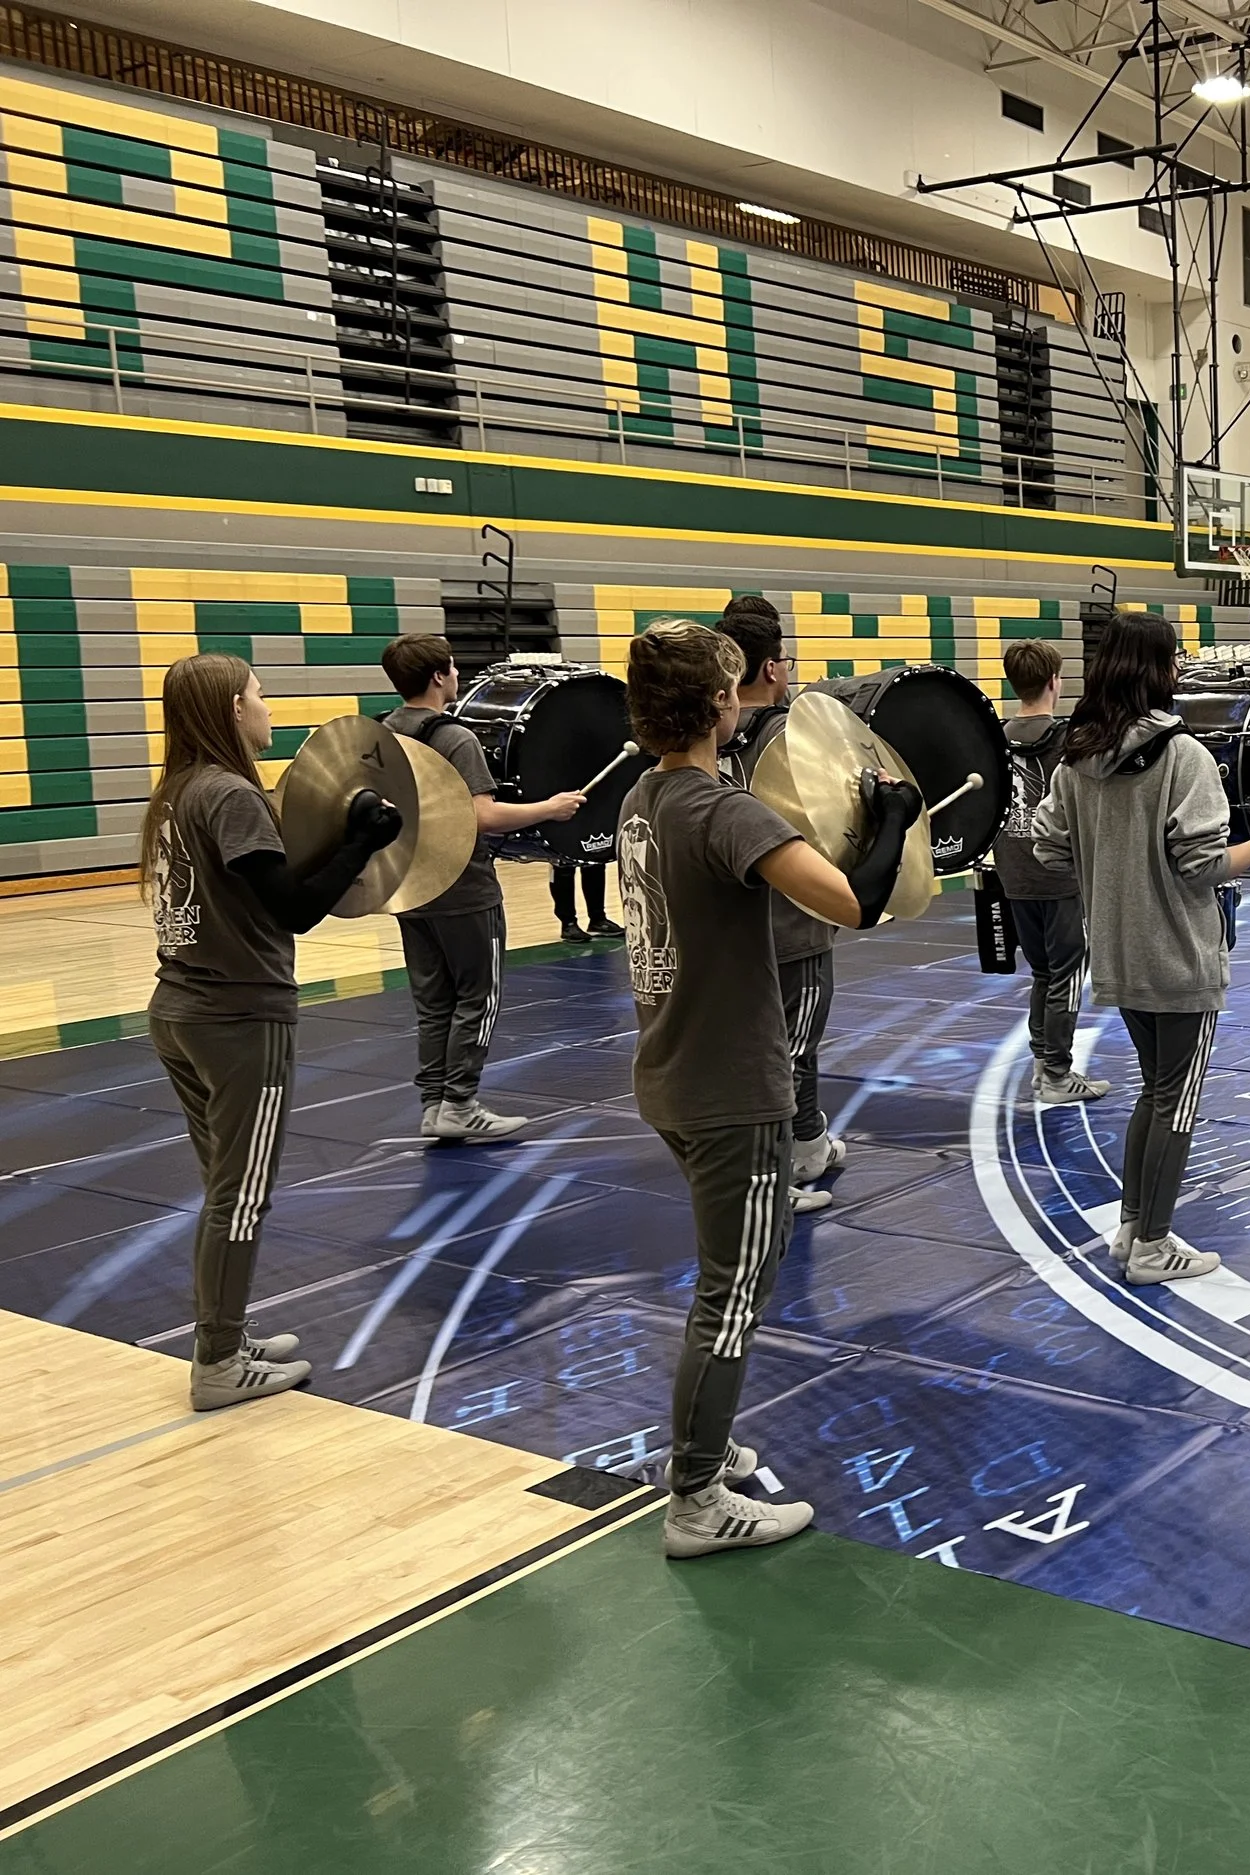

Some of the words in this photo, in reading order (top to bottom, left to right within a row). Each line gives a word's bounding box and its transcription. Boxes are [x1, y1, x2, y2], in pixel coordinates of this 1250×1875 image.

[587, 839, 609, 849] REMO
[935, 844, 960, 854] REMO
[991, 901, 1002, 922] VIC
